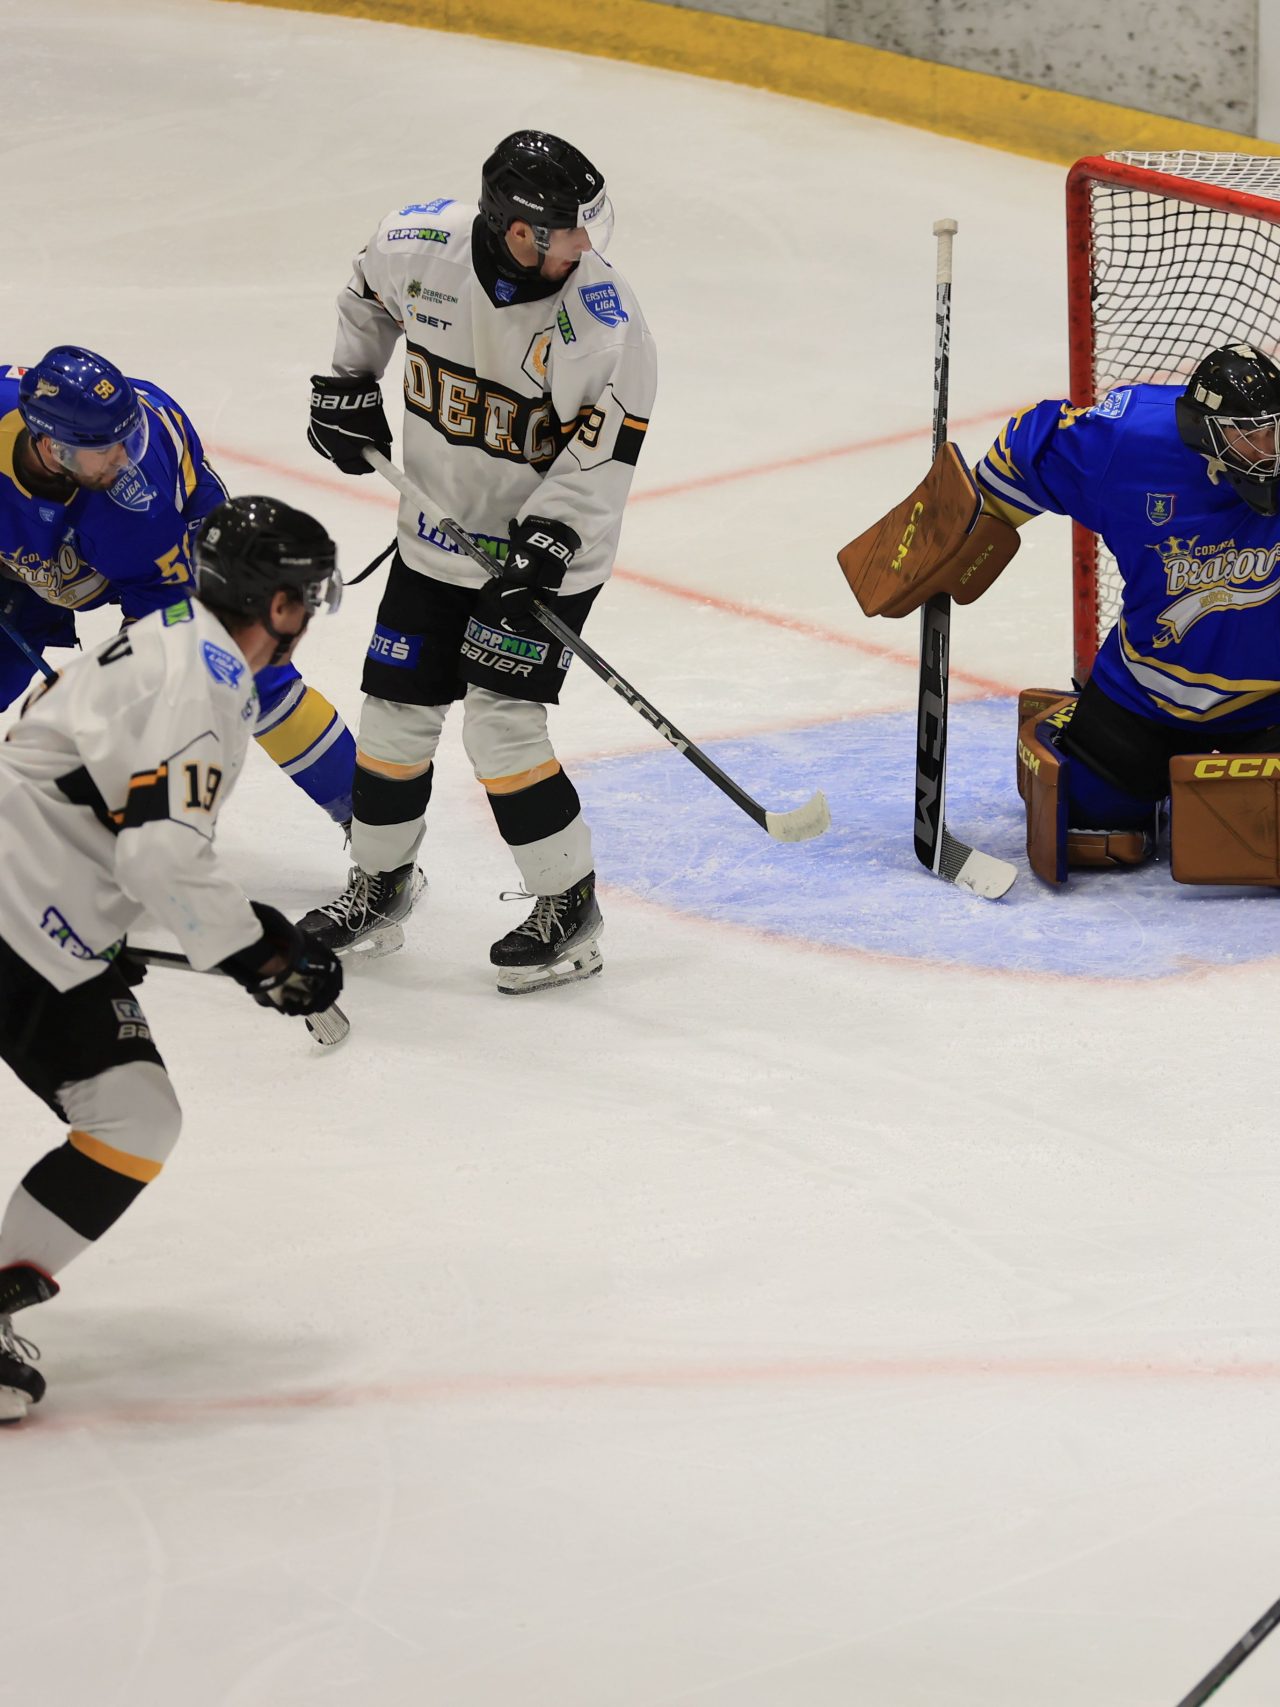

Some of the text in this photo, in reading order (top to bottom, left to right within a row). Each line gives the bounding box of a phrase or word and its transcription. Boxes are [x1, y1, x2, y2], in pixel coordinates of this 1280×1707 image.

[585, 173, 596, 186] 9
[423, 288, 459, 304] DEBRECENI
[585, 289, 609, 303] ERSTE
[594, 299, 616, 312] LIGA
[416, 313, 452, 331] SET
[94, 379, 116, 399] 58
[576, 406, 606, 449] 9
[122, 480, 142, 501] LIGA
[206, 527, 221, 543] 19
[460, 641, 533, 678] BAUER
[915, 607, 950, 848] CCM
[184, 761, 222, 813] 19
